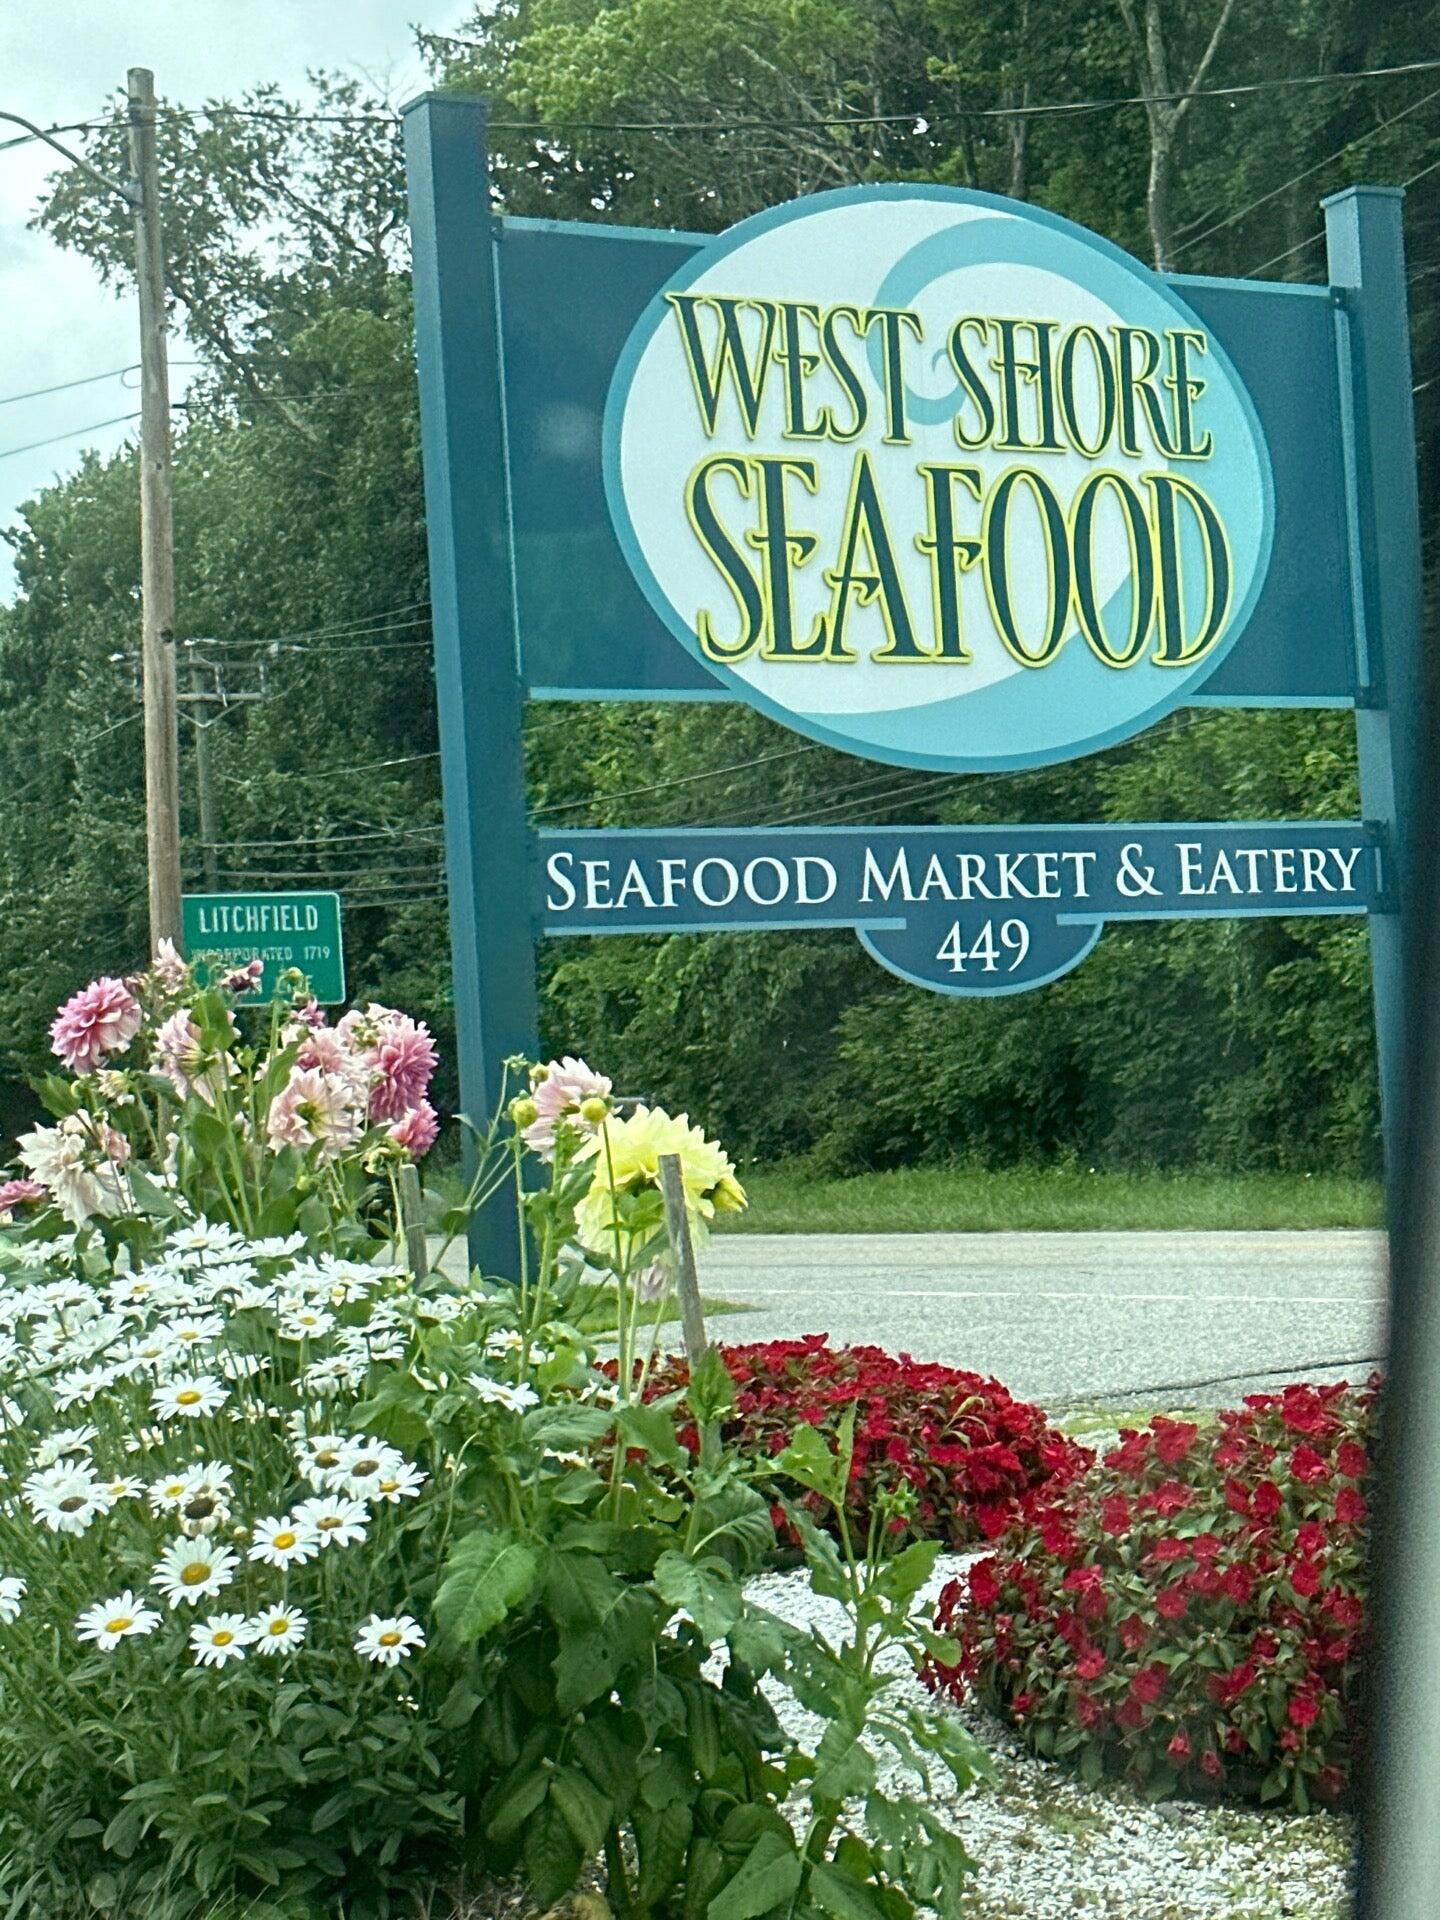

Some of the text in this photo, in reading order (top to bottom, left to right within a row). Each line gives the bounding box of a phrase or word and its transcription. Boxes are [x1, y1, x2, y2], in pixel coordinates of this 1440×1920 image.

[664, 292, 1212, 460] WEST SHORE
[684, 450, 1234, 670] SEAFOOD
[1116, 843, 1164, 897] &
[199, 904, 319, 933] LITCHFIELD
[936, 918, 1030, 973] 449
[303, 945, 331, 961] 1719
